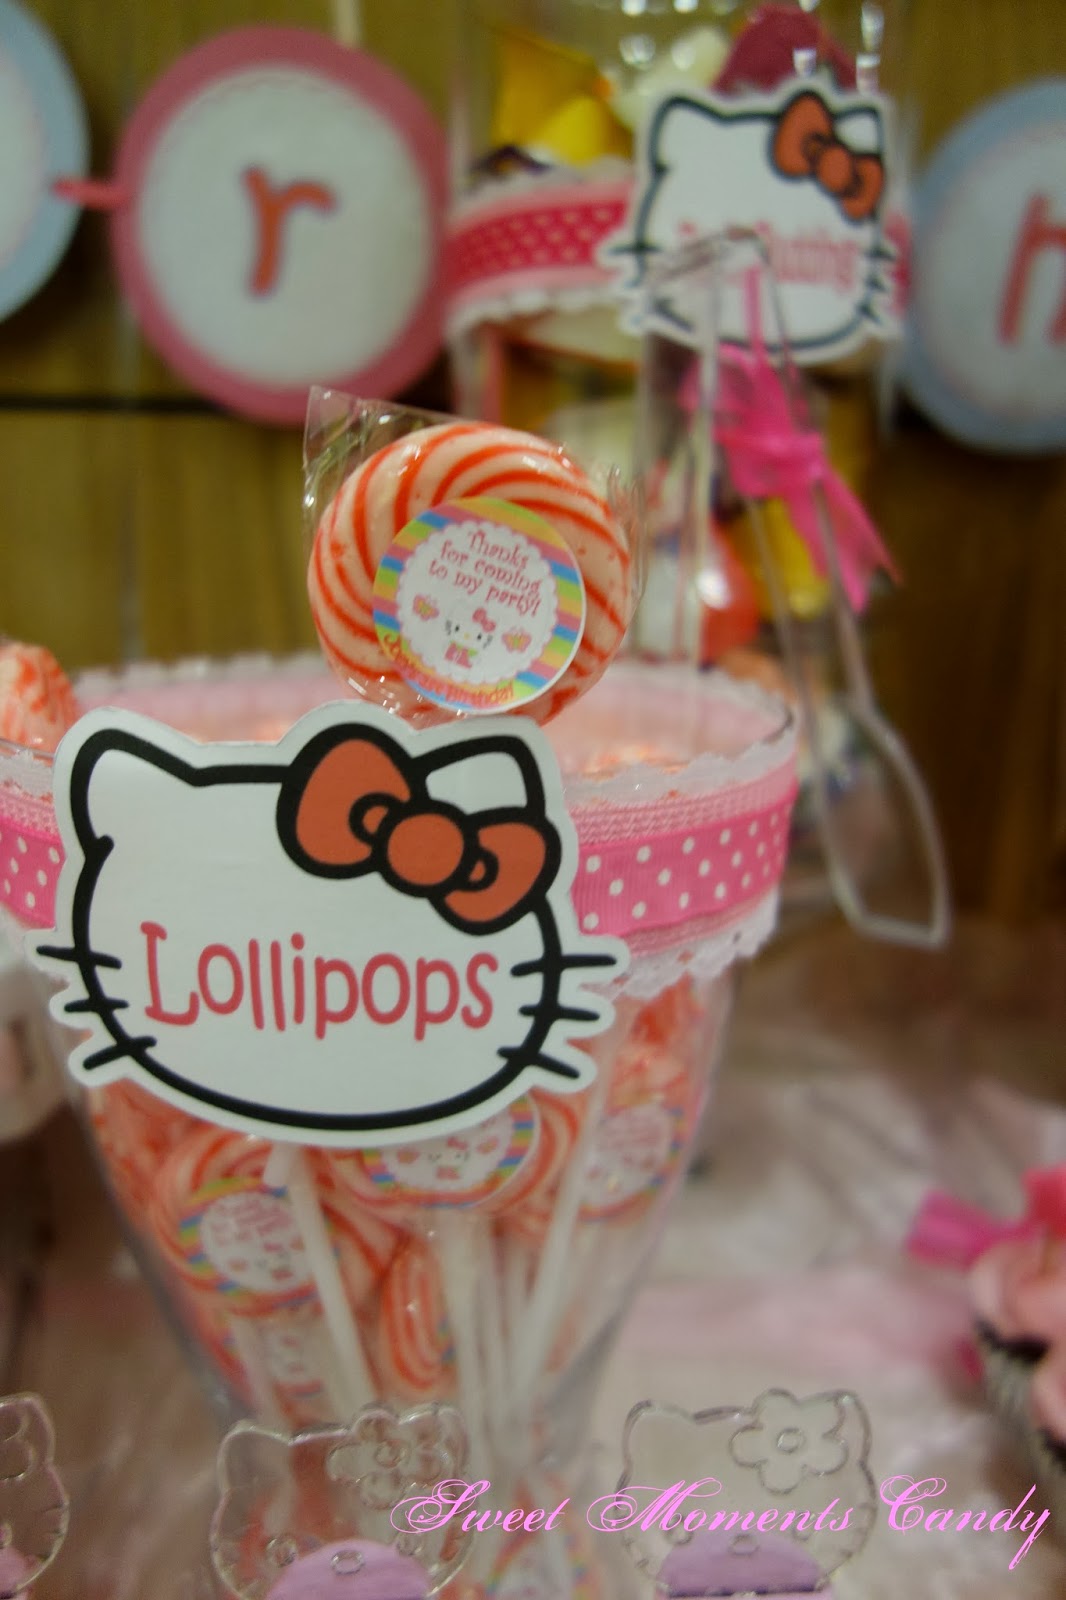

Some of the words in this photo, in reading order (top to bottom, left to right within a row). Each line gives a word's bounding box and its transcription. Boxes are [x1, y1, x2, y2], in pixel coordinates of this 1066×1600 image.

[244, 166, 335, 297] r
[440, 539, 469, 567] for
[474, 558, 542, 598] coming
[467, 529, 528, 570] Thanks
[428, 559, 448, 580] to
[454, 571, 483, 595] my
[485, 585, 541, 617] party!
[140, 921, 499, 1041] Lollipops
